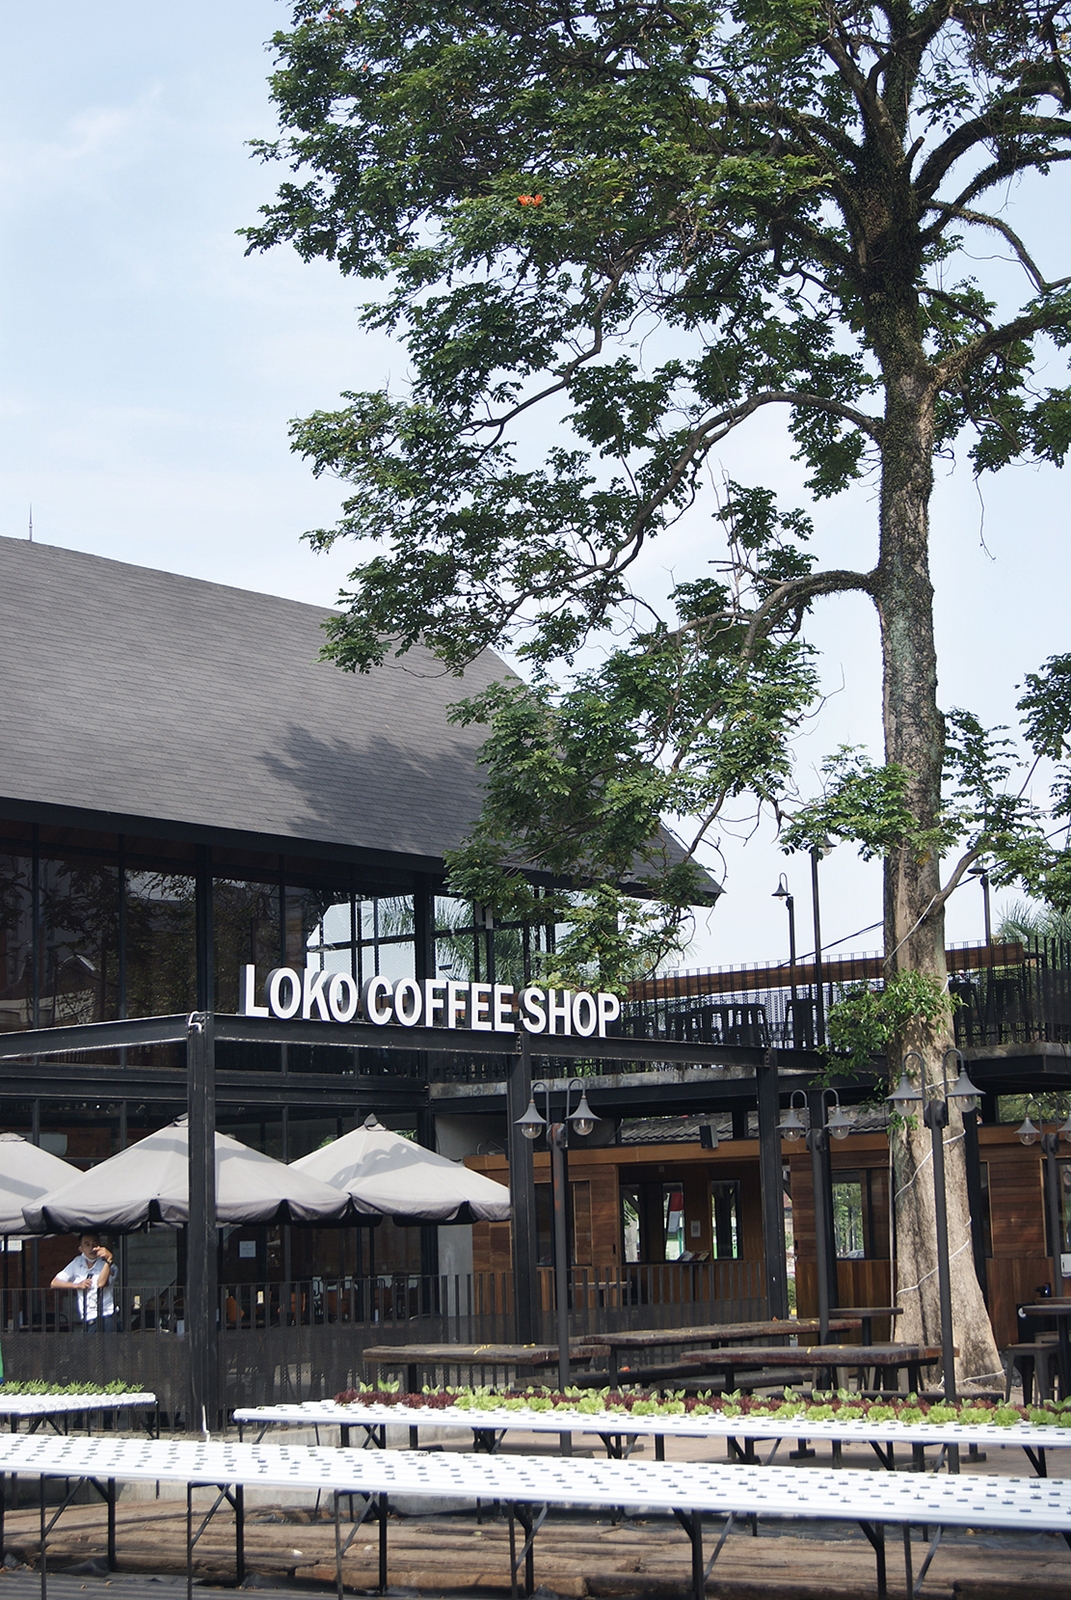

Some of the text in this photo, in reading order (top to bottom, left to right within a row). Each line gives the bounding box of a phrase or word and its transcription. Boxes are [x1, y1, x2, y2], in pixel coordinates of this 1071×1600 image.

[243, 964, 620, 1038] LOKO COFFEE SHOP
